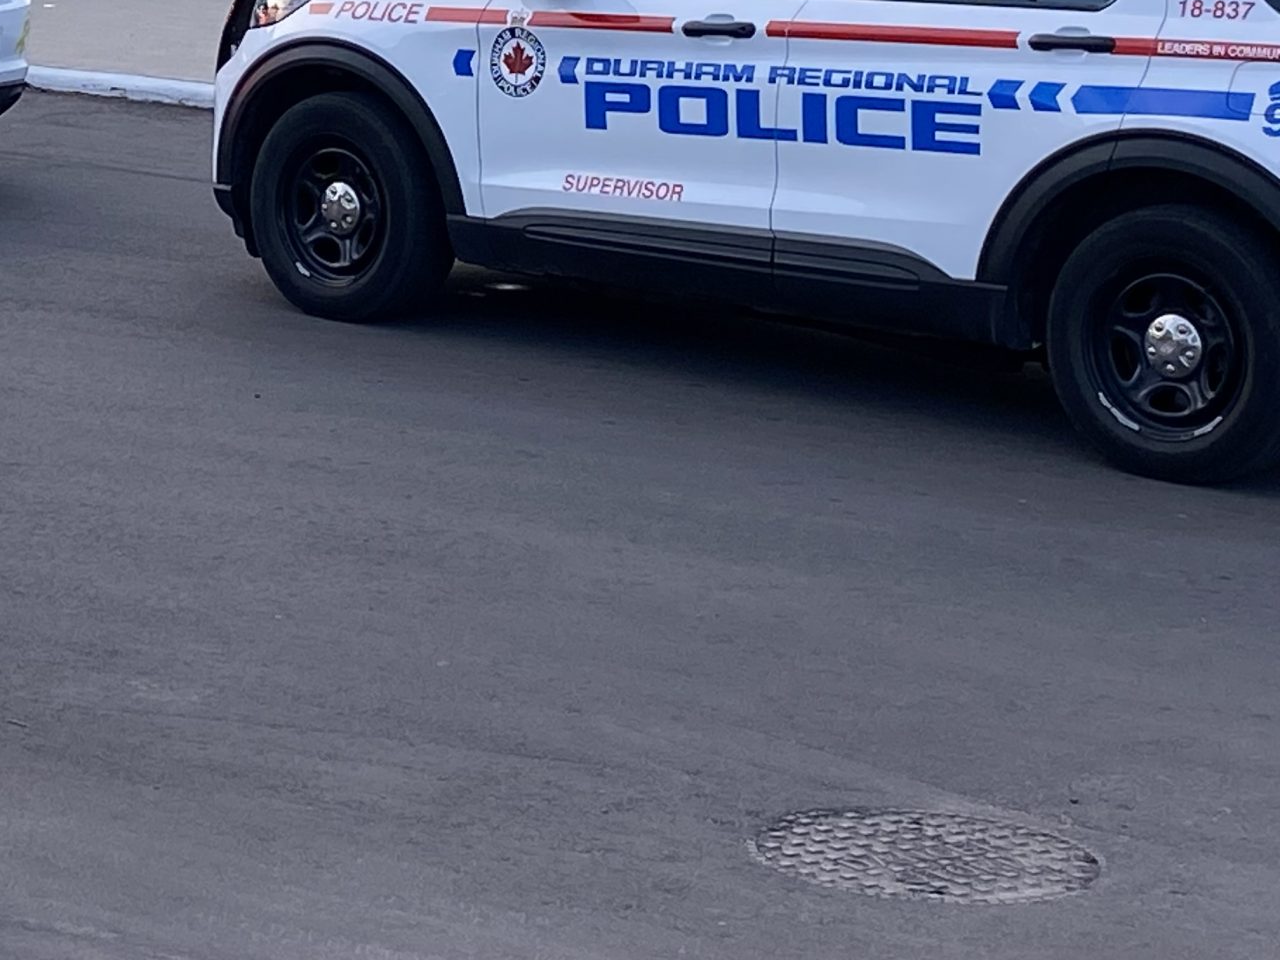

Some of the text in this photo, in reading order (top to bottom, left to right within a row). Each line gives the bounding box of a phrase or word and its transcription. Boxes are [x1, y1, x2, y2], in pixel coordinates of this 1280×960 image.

[335, 1, 423, 24] POLICE
[1157, 42, 1210, 55] LEADERS
[1212, 43, 1225, 56] IN
[585, 57, 983, 96] DURHAM REGIONAL
[584, 81, 982, 156] POLICE
[562, 174, 684, 202] SUPERVISOR
